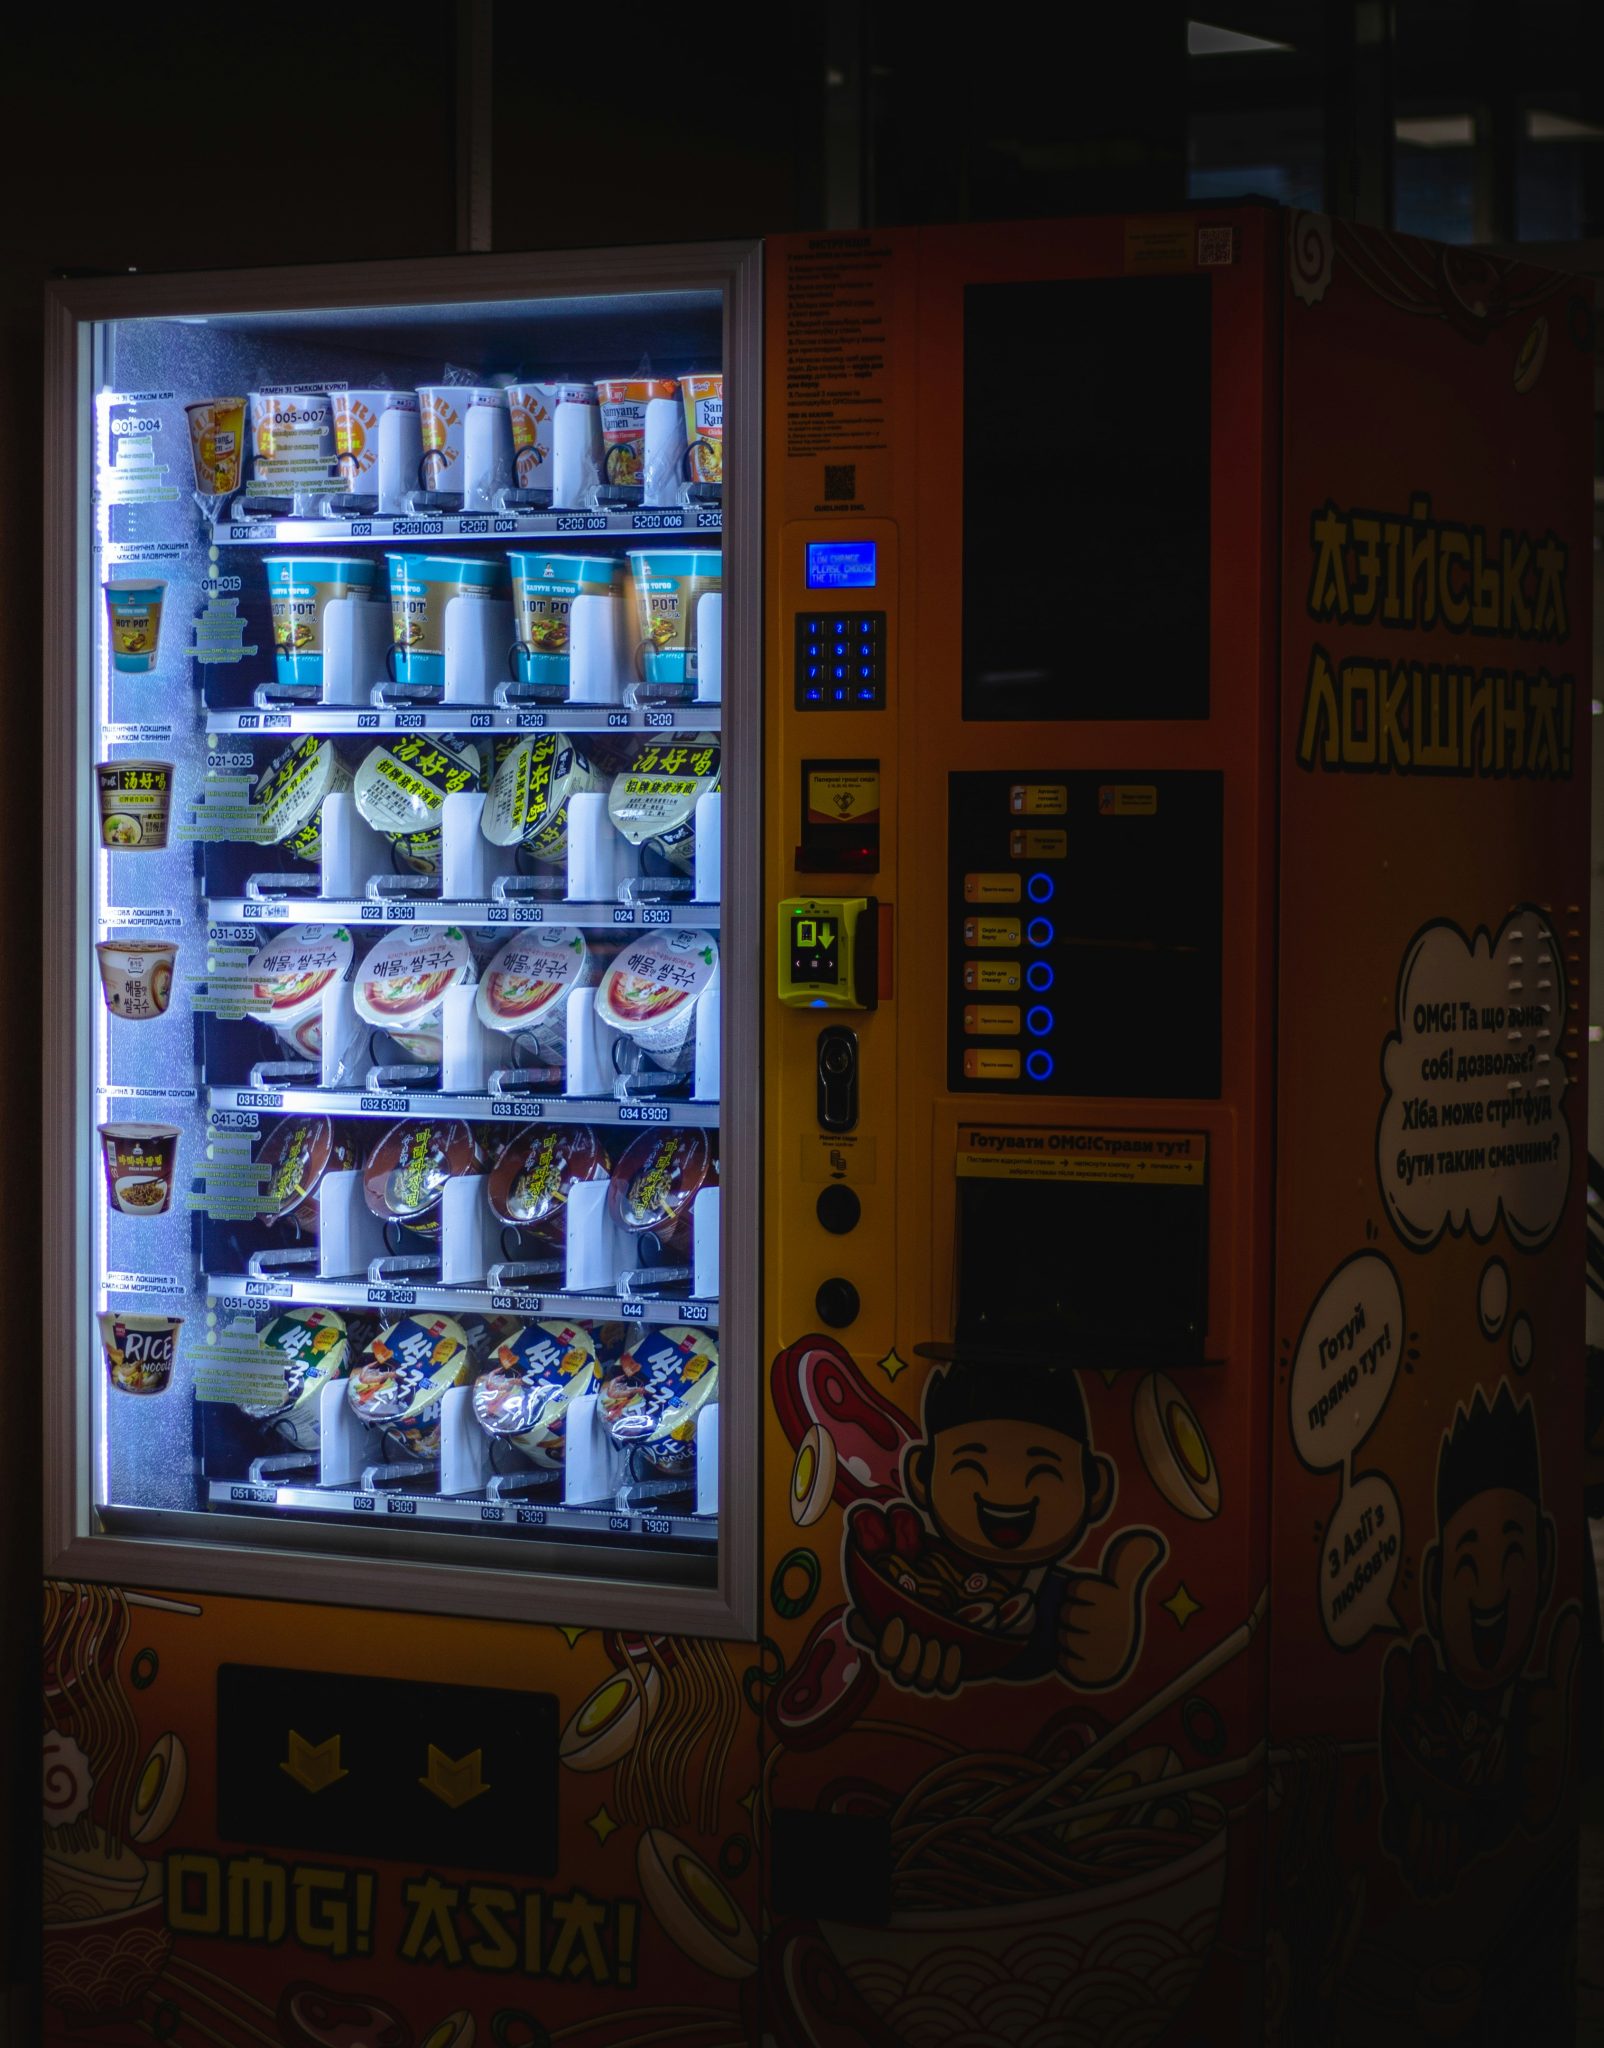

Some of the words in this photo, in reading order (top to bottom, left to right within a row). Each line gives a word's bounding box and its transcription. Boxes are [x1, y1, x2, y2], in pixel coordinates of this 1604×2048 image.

[261, 387, 284, 395] РАМЕН
[294, 385, 323, 394] СМАКОМ
[325, 383, 347, 391] КУРКИ
[275, 411, 324, 424] 005-007
[603, 406, 641, 419] Samyang
[114, 420, 160, 432] 001-004
[495, 520, 513, 531] 004
[587, 518, 606, 529] 005
[663, 516, 682, 527] 006
[232, 527, 248, 538] 001
[353, 525, 370, 535] 002
[423, 522, 441, 533] 003
[1309, 492, 1569, 642] АЗІЙСЬКА
[202, 578, 240, 590] 011-015
[292, 603, 315, 615] POT
[403, 602, 426, 613] POT
[551, 602, 571, 613] PO
[652, 599, 678, 611] POT
[116, 619, 129, 628] HOT
[134, 619, 149, 628] POT
[811, 623, 816, 633] 1
[836, 624, 842, 633] 2
[863, 623, 868, 633] 3
[837, 645, 843, 655] 5
[862, 645, 868, 655] 6
[810, 667, 816, 678] 7
[836, 667, 842, 678] 8
[863, 667, 868, 678] 9
[836, 690, 842, 700] 0
[1298, 643, 1575, 779] ЛОКШИНА!
[240, 717, 257, 727] 011
[359, 716, 377, 727] 012
[472, 715, 490, 726] 013
[609, 715, 628, 725] 014
[208, 755, 252, 766] 021-025
[633, 747, 713, 776] 汤好喝
[124, 771, 166, 791] 汤好喝
[132, 909, 165, 917] ЛОКШИНА
[245, 905, 262, 916] 021
[362, 907, 380, 918] 022
[489, 908, 507, 919] 023
[614, 910, 633, 921] 024
[128, 918, 181, 926] МОРЕПРОДУКТІВ
[210, 928, 255, 940] 031-035
[297, 951, 337, 970] 쌀국수
[410, 952, 455, 973] 쌀국수
[533, 958, 569, 980] 쌀국수
[657, 962, 697, 988] 쌀국수
[124, 998, 149, 1014] 쌀국수
[1414, 1003, 1457, 1034] OMG!
[1460, 1003, 1477, 1031] Та
[1482, 1006, 1504, 1033] що
[1422, 1048, 1453, 1081] собі
[135, 1088, 167, 1097] БОБОВИМ
[168, 1089, 196, 1097] СОУСОМ
[238, 1094, 255, 1105] 031
[361, 1099, 380, 1110] 032
[493, 1104, 511, 1115] 033
[620, 1108, 638, 1119] 034
[1402, 1098, 1438, 1130] Хіба
[1441, 1102, 1483, 1126] може
[1486, 1091, 1552, 1125] стрітфуд
[212, 1113, 258, 1125] 041-045
[970, 1132, 1044, 1151] Готувати
[1156, 1139, 1191, 1156] тут!
[1397, 1149, 1434, 1185] бути
[1437, 1148, 1485, 1175] таким
[1488, 1133, 1560, 1169] смачним?
[136, 1276, 167, 1284] ЛОКШИНА
[131, 1284, 185, 1294] МОРЕПРОДУКТІВ
[246, 1283, 263, 1295] 041
[369, 1290, 387, 1301] 042
[224, 1297, 269, 1310] 051-055
[493, 1298, 511, 1309] 043
[623, 1304, 642, 1316] 044
[1319, 1303, 1366, 1370] Готуй
[125, 1333, 172, 1361] RICE
[142, 1362, 171, 1372] NOODLE
[1308, 1368, 1358, 1430] прямо
[1360, 1324, 1391, 1385] тут!
[232, 1488, 249, 1499] 051
[354, 1497, 372, 1509] 052
[482, 1508, 500, 1519] 053
[610, 1517, 629, 1529] 054
[1329, 1552, 1339, 1579] З
[1343, 1507, 1373, 1566] Азії
[1374, 1505, 1385, 1527] з
[1332, 1534, 1397, 1621] любов'ю
[164, 1848, 377, 1958] OMG!
[400, 1877, 641, 1989] ASIA!
